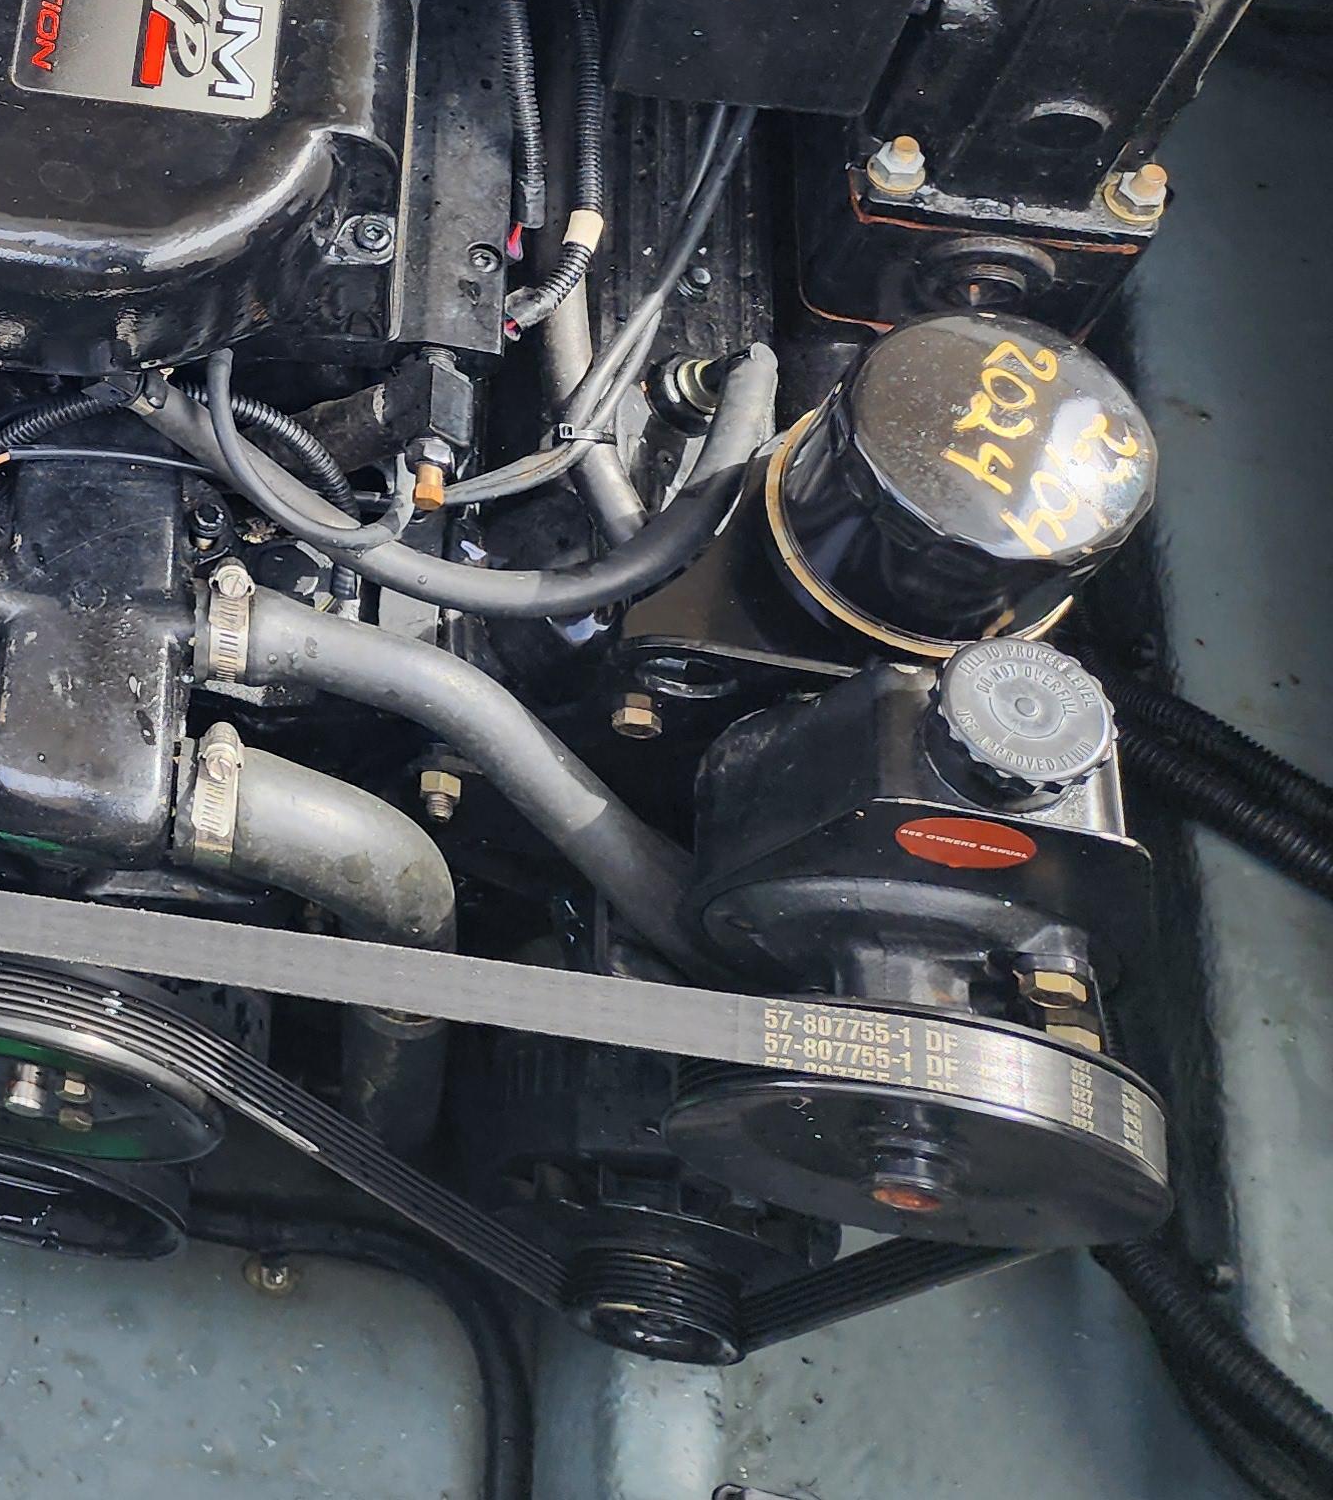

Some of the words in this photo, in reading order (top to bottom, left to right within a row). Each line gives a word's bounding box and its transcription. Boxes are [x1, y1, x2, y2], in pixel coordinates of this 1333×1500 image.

[939, 340, 1059, 495] 2024
[959, 652, 985, 676] FILL
[987, 645, 1001, 659] TO
[1064, 668, 1098, 708] LEVEL
[976, 678, 994, 694] DO
[991, 663, 1018, 681] NOT
[1024, 666, 1078, 716] OVERFILL
[956, 708, 979, 733] USE
[976, 733, 1056, 771] APPROVED
[1059, 739, 1095, 769] FLUID
[900, 828, 924, 837] SEE
[926, 834, 978, 848] OWNERS
[980, 844, 1028, 859] MANUAL
[764, 1008, 913, 1048] 57-807755-1
[925, 1029, 960, 1053] DF
[764, 1033, 913, 1072] 57-807755-1
[925, 1054, 960, 1079] DF
